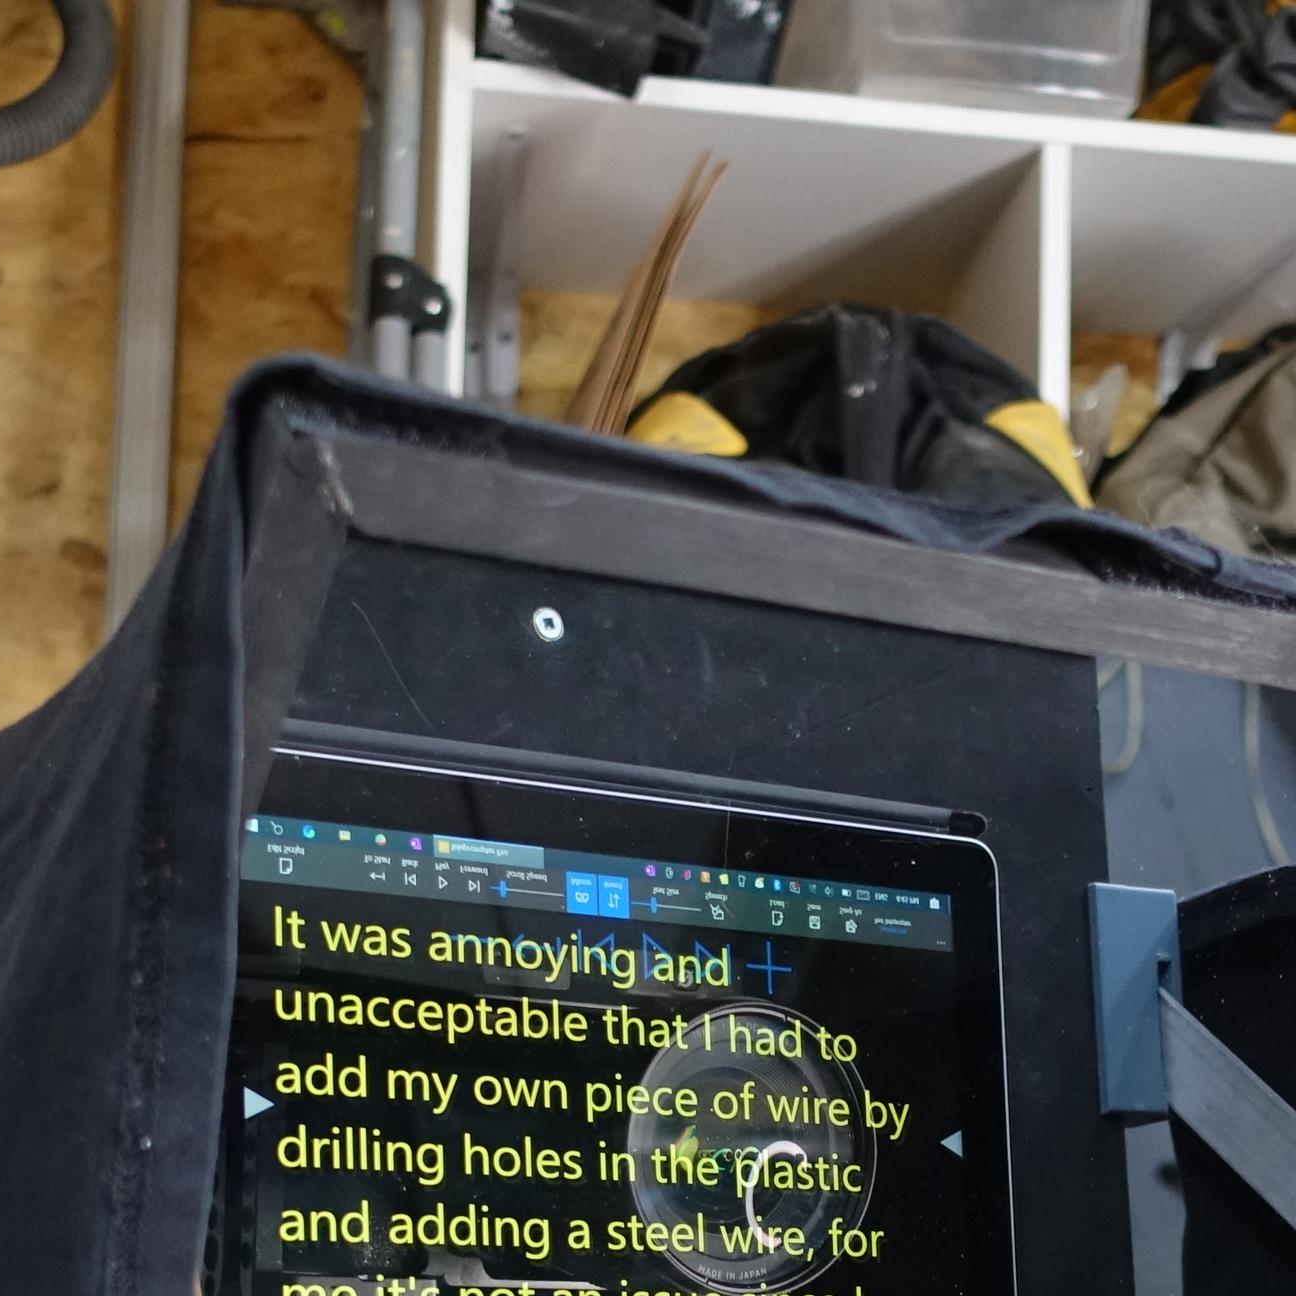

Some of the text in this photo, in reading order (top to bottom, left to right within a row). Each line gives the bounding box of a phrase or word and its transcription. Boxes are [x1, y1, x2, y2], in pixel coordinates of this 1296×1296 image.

[273, 905, 730, 989] It was annoying and
[274, 988, 858, 1062] unacceptable that I had to
[275, 1052, 911, 1140] add my own piece of wire by
[277, 1124, 863, 1198] drilling holes in the plastic
[279, 1200, 885, 1262] and adding a steel wire, for
[698, 1263, 768, 1281] MADE IN JAPAN
